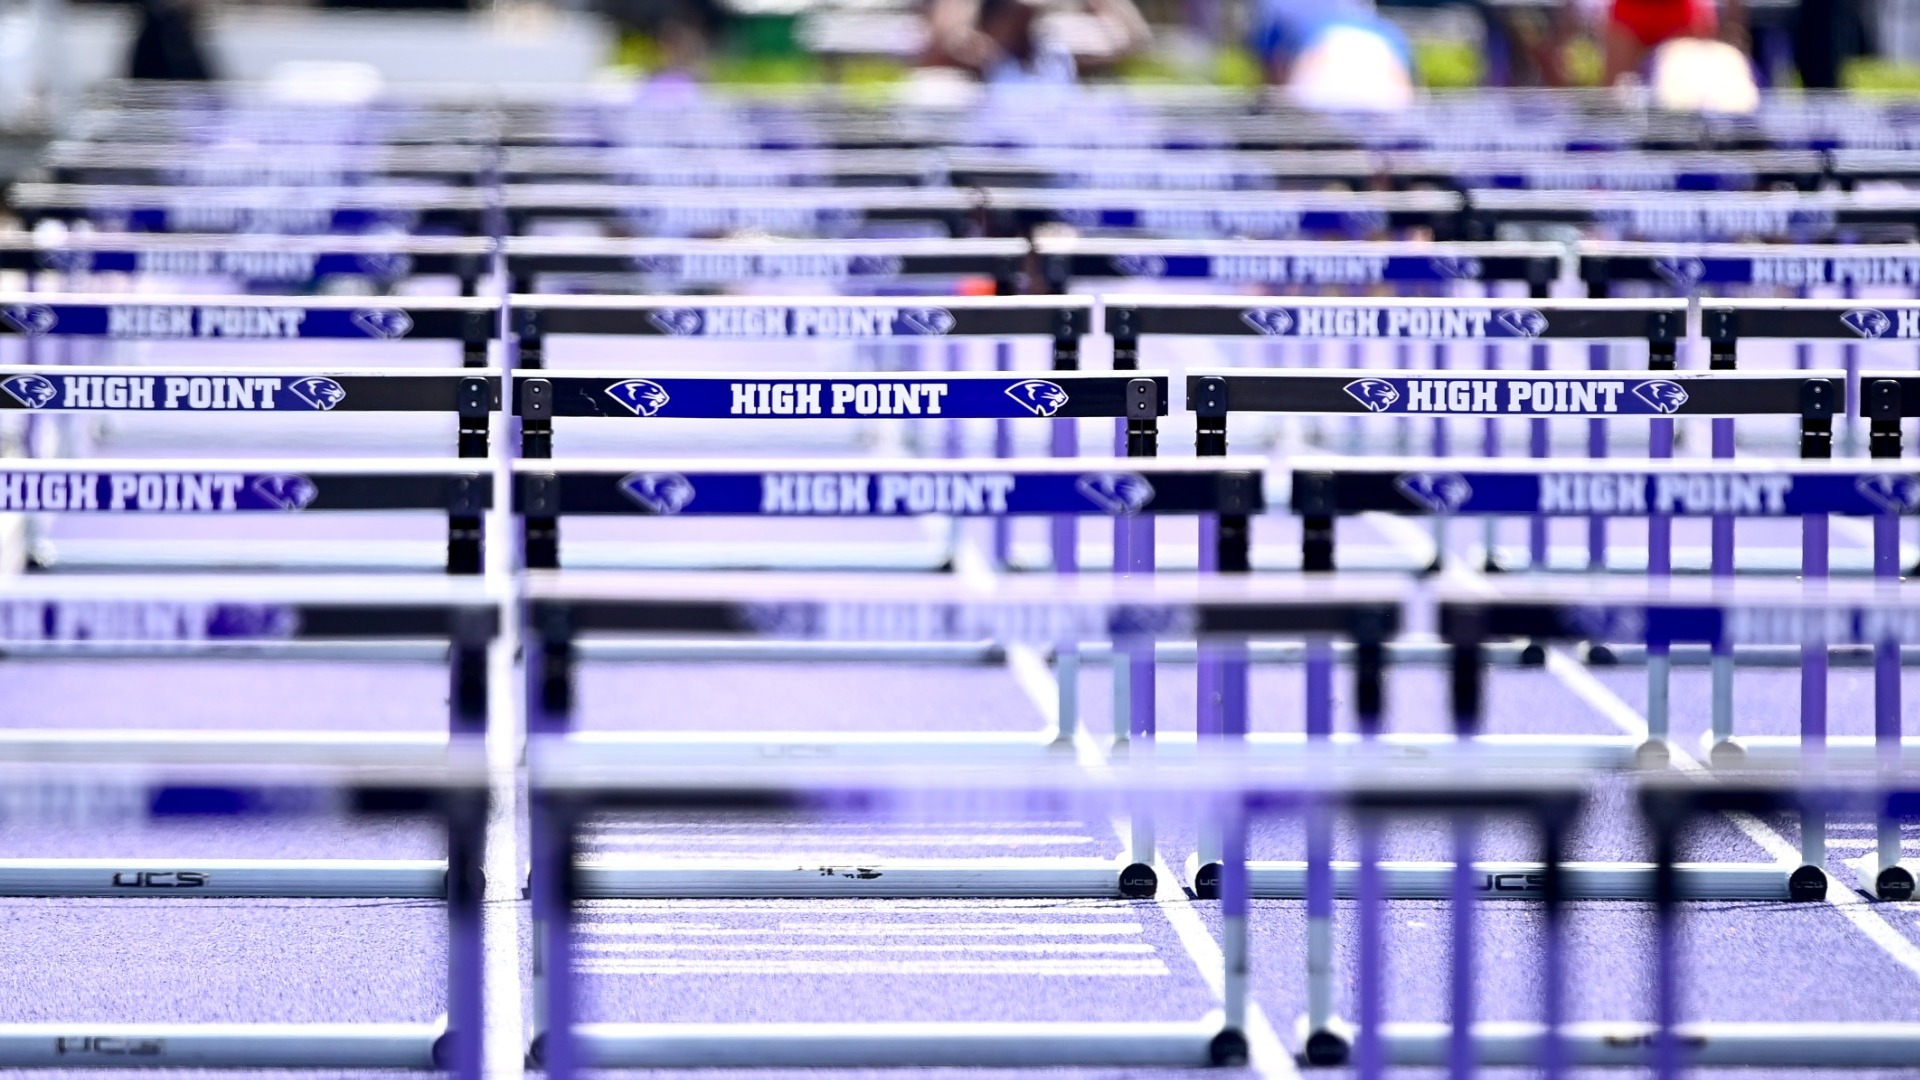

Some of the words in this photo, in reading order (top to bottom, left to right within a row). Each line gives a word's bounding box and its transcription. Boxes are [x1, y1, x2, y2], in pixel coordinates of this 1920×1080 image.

[107, 307, 194, 338] HIGH
[201, 307, 305, 338] POINT
[705, 307, 789, 336] HIGH
[792, 308, 899, 336] POINT
[1299, 307, 1383, 337] HIGH
[1386, 308, 1491, 338] POINT
[63, 377, 155, 409] HIGH
[164, 377, 281, 409] POINT
[730, 383, 822, 414] HIGH
[830, 383, 948, 414] POINT
[1406, 380, 1498, 412] HIGH
[1507, 381, 1624, 412] POINT
[0, 474, 98, 510] HIGH
[110, 474, 244, 510] POINT
[760, 473, 871, 513] HIGH
[878, 473, 1015, 513] POINT
[1538, 473, 1648, 513] HIGH
[1655, 474, 1793, 513] POINT
[112, 872, 208, 887] UCS
